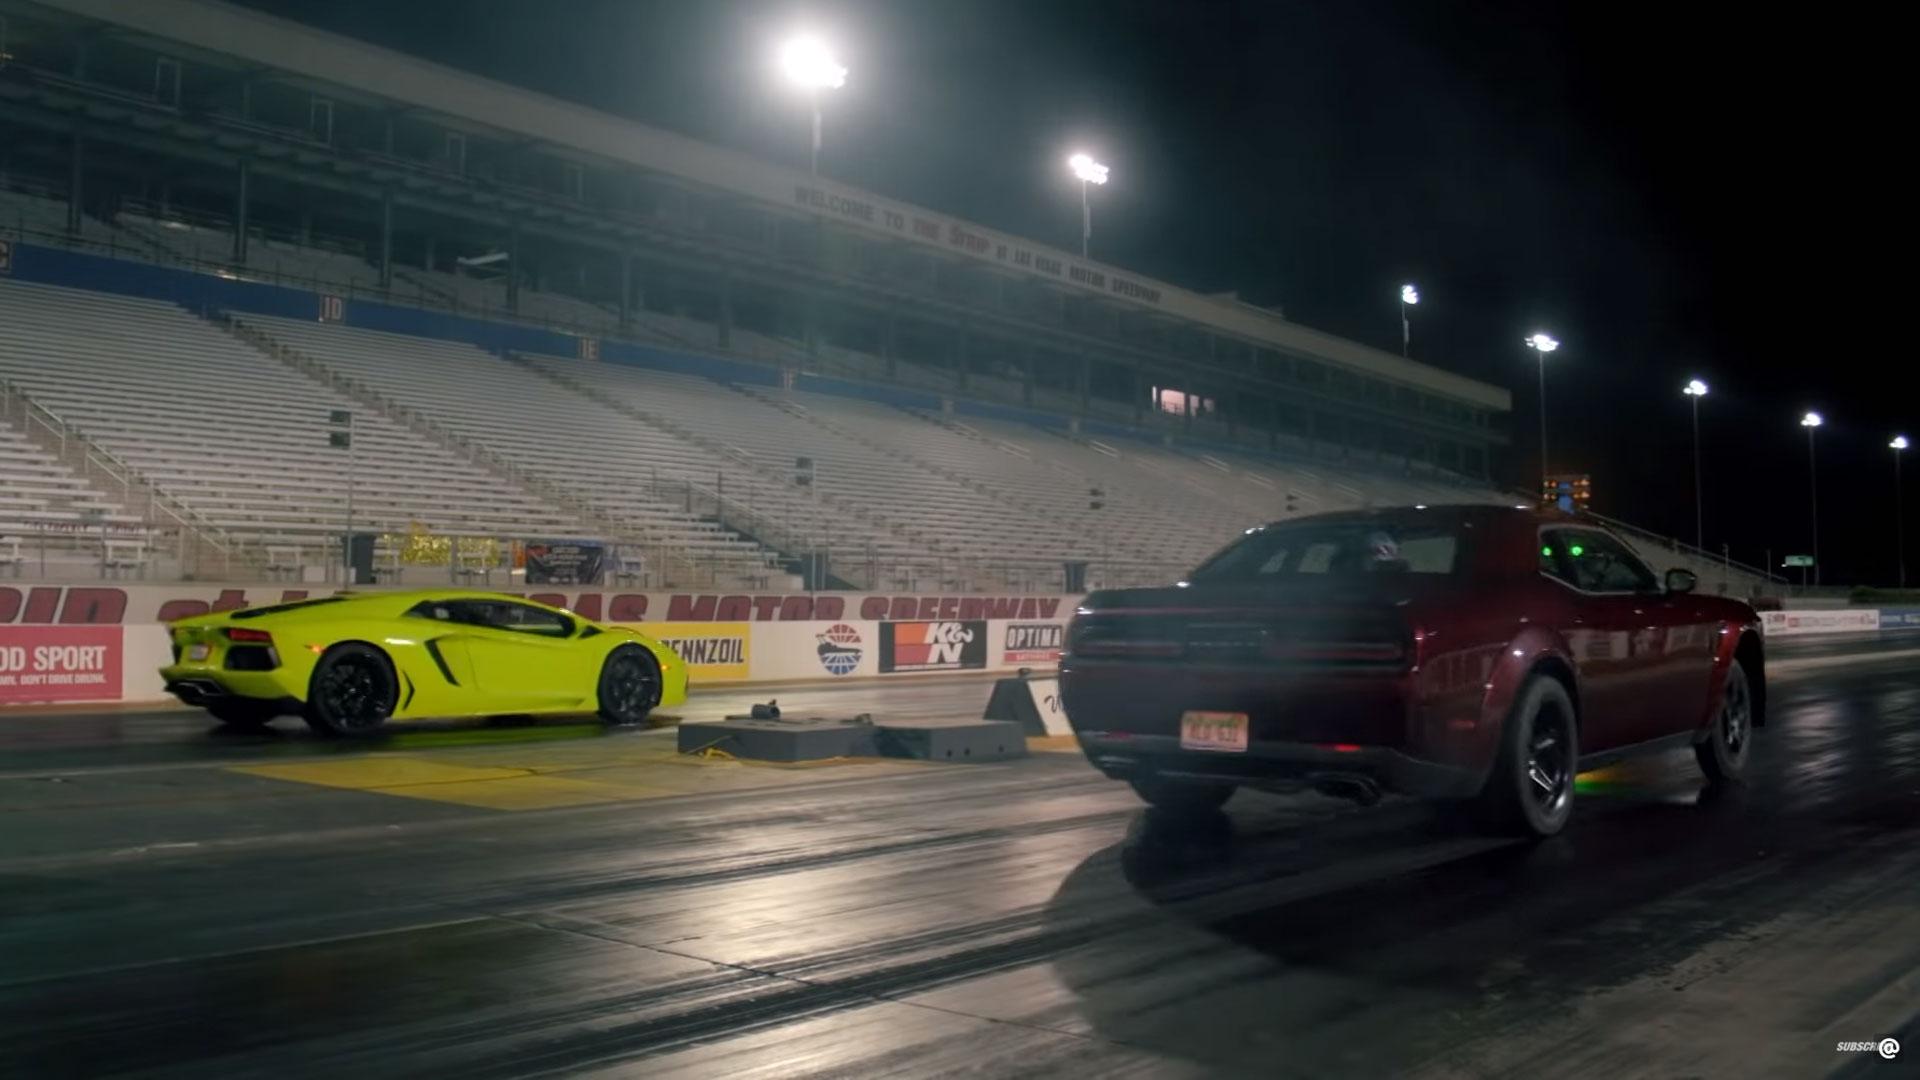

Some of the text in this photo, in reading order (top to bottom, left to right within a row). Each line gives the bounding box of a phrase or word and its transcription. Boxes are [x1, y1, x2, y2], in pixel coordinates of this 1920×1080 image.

[795, 186, 876, 222] WELCOME
[884, 210, 906, 231] TO
[912, 217, 940, 242] THE
[666, 595, 846, 621] MOTOR
[1007, 627, 1061, 648] OPTIMA
[33, 645, 107, 671] SPORT
